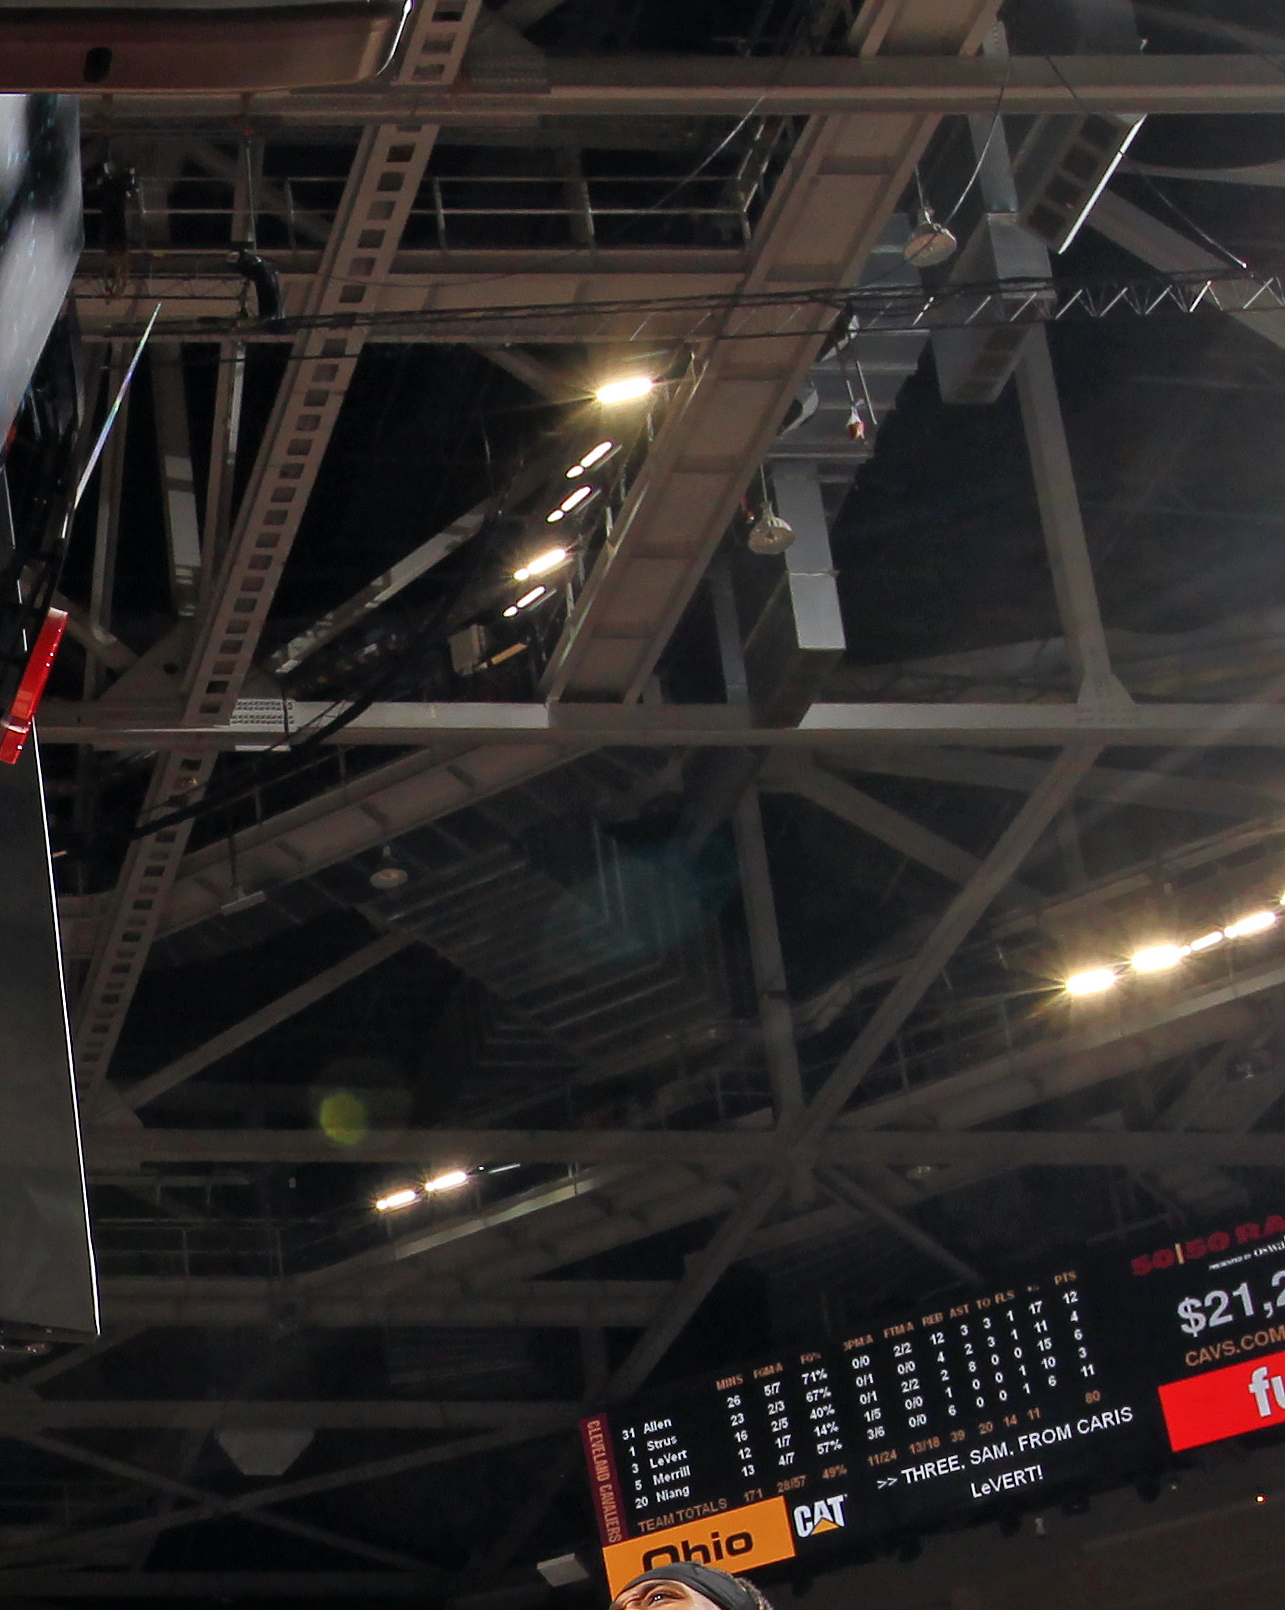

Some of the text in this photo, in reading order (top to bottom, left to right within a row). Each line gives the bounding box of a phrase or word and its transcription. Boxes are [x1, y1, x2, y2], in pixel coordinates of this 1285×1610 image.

[622, 1291, 1078, 1440] 31 Allen 26 5/7 71% 0/0 2/2 12 17 12
[647, 1320, 1048, 1451] Strus 23 2/3 67% 0/1 0/0 11
[649, 1450, 688, 1469] LeVert
[734, 1431, 748, 1443] 16
[809, 1404, 835, 1420] 40%
[859, 1391, 878, 1405] 0/1
[901, 1378, 920, 1393] 2/2
[1037, 1338, 1052, 1351] 15
[587, 1420, 622, 1543] CLEVELAND CAVALIERS
[635, 1414, 927, 1510] 20 Niang 13 4/7 57% 3/6 0/0
[638, 1514, 674, 1533] TEAM
[678, 1498, 728, 1522] TOTALS
[743, 1487, 763, 1503] 171
[822, 1464, 848, 1480] 49%
[867, 1449, 898, 1467] 11/24
[908, 1437, 941, 1455] 13/18
[950, 1430, 966, 1442] 39
[979, 1421, 994, 1435] 20
[1003, 1414, 1018, 1428] 14
[1027, 1407, 1040, 1421] 11
[1085, 1390, 1101, 1404] 80
[653, 1396, 923, 1486] Merrill 12 1/7 14% 1/5 0/0
[901, 1407, 1134, 1485] THREE. SAM. FROM CARIS
[970, 1465, 1044, 1499] LeVERT!
[642, 1532, 753, 1571] Ohio
[793, 1495, 847, 1538] CAT
